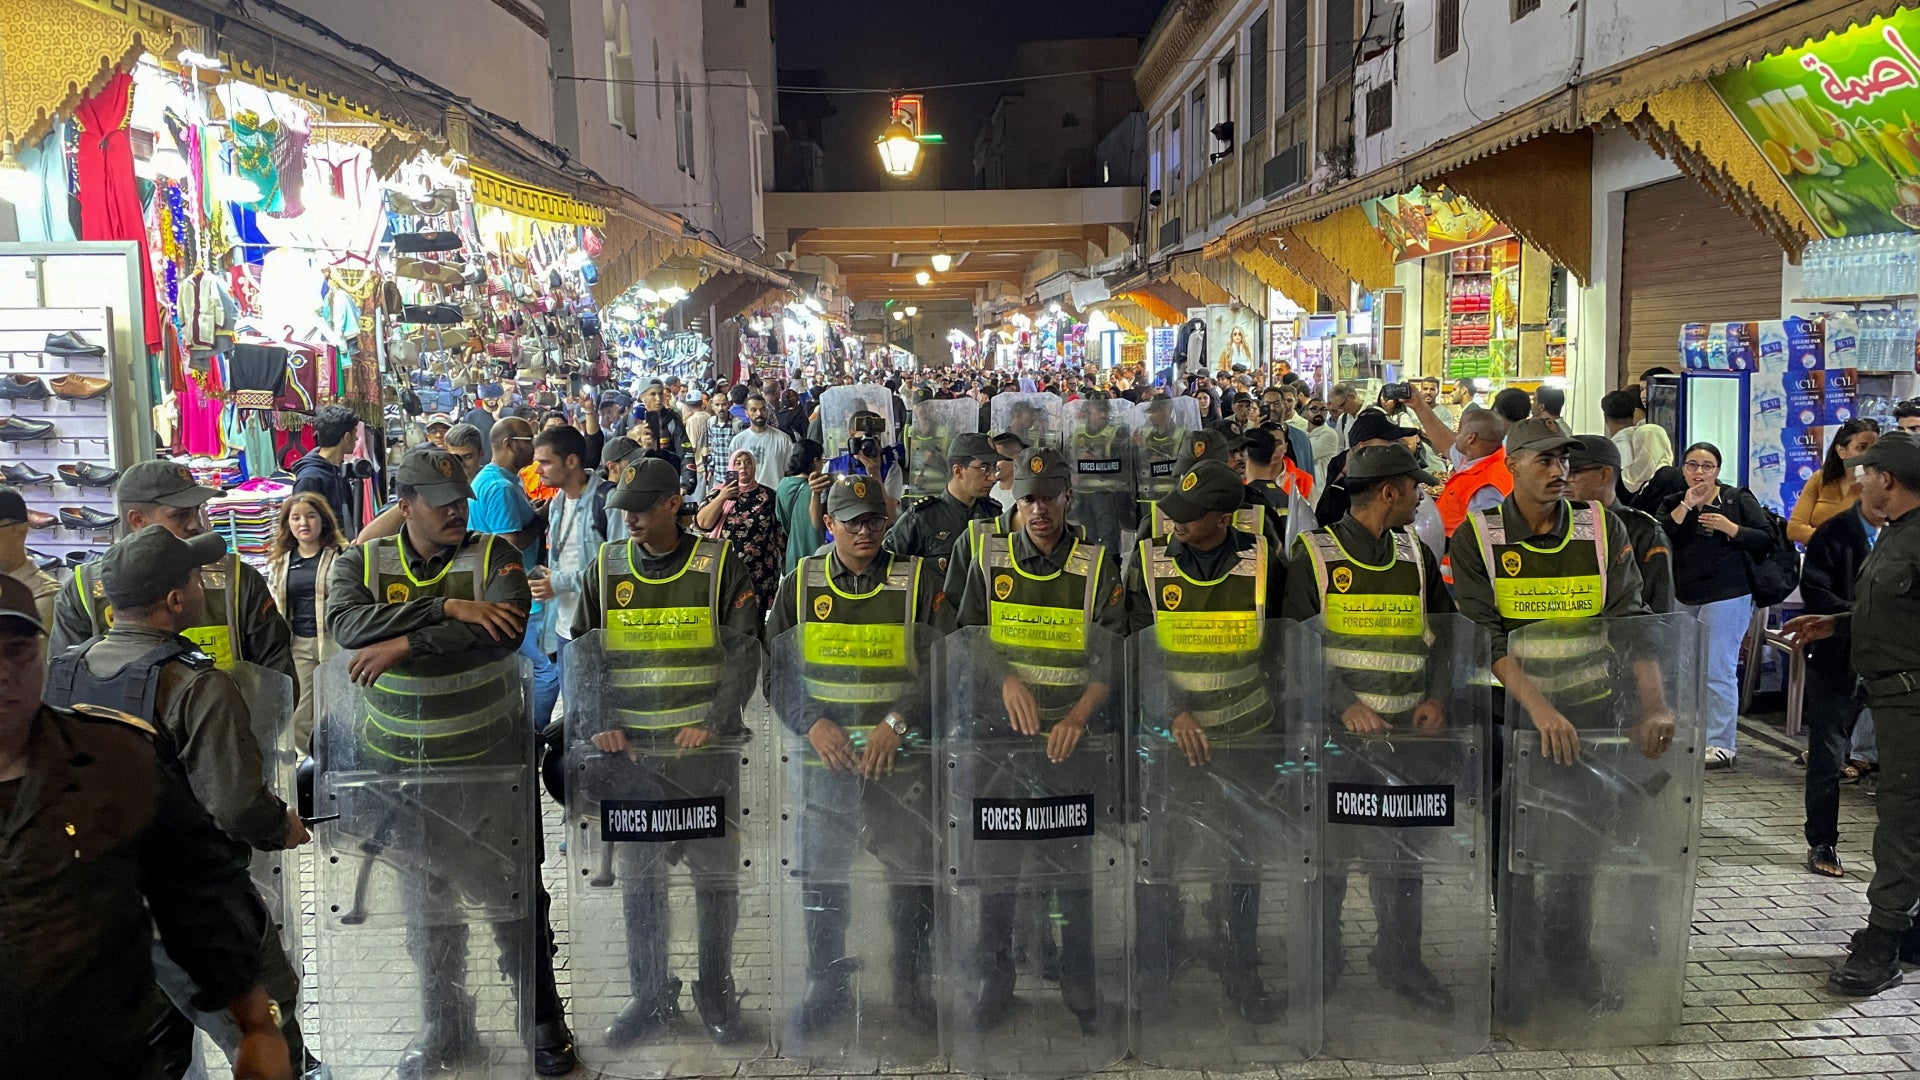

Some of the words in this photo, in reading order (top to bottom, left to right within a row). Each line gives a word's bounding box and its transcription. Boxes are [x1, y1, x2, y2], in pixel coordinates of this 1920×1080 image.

[1793, 322, 1819, 333] ACYL
[1792, 378, 1818, 390] ACYL
[1828, 376, 1854, 388] ACYL
[1792, 434, 1817, 446] ACYL
[1080, 462, 1095, 471] FORCES
[1153, 464, 1168, 474] FORCES
[1514, 601, 1546, 612] FORCES
[1547, 600, 1592, 612] AUXILIAIRES
[1343, 617, 1374, 628] FORCES
[1001, 626, 1026, 639] FORCES
[1027, 629, 1072, 642] AUXILIAIRES
[1172, 634, 1202, 645] FORCES
[819, 646, 847, 657] FORCES
[1336, 791, 1378, 817] FORCES
[1382, 793, 1447, 818] AUXILIAIRES
[608, 809, 647, 833] FORCES
[651, 805, 717, 833] AUXILIAIRES
[981, 807, 1021, 831] FORCES
[1025, 803, 1087, 831] AUXILIAIRES
